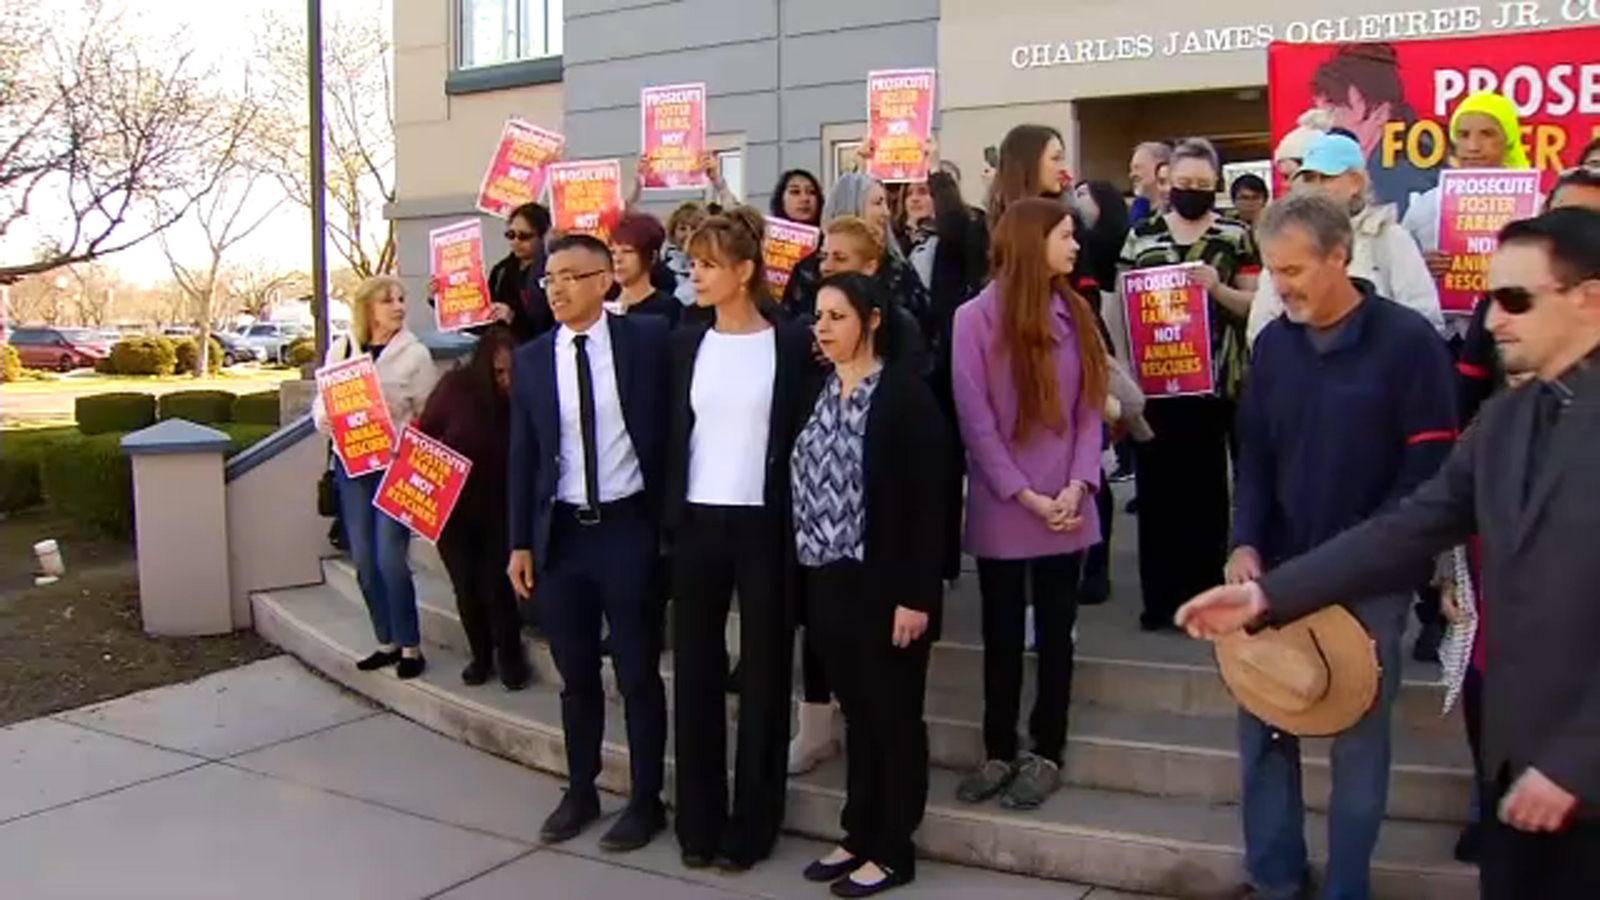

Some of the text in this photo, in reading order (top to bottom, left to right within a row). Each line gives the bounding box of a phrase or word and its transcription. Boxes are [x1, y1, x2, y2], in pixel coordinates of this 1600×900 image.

[1011, 34, 1153, 69] CHARLES
[1162, 23, 1274, 56] JAMES
[1286, 6, 1482, 43] OGLETREE
[1491, 1, 1549, 29] JR.
[871, 75, 931, 91] PROSECUTE
[646, 89, 702, 106] PROSECUTE
[888, 120, 909, 136] NOT
[661, 132, 684, 147] NOT
[1380, 119, 1567, 170] FOR
[1445, 177, 1535, 195] PROSECUTE
[1458, 196, 1516, 214] FOSTER
[574, 214, 599, 230] NOT
[1451, 254, 1491, 272] ANI
[1127, 272, 1191, 294] PROSECU
[1444, 273, 1490, 291] RESC
[1140, 289, 1189, 308] FOSTER
[1154, 326, 1181, 342] NOT
[1144, 341, 1196, 360] ANIMAL
[1141, 357, 1202, 376] RESCUERS
[320, 363, 375, 390] PROSECUTE
[346, 411, 370, 427] NOT
[343, 423, 384, 444] ANIMAL
[404, 430, 467, 473] PROSECUTE
[410, 472, 435, 496] NOT
[395, 479, 440, 513] ANIMAL
[386, 486, 438, 527] RESCUERS
